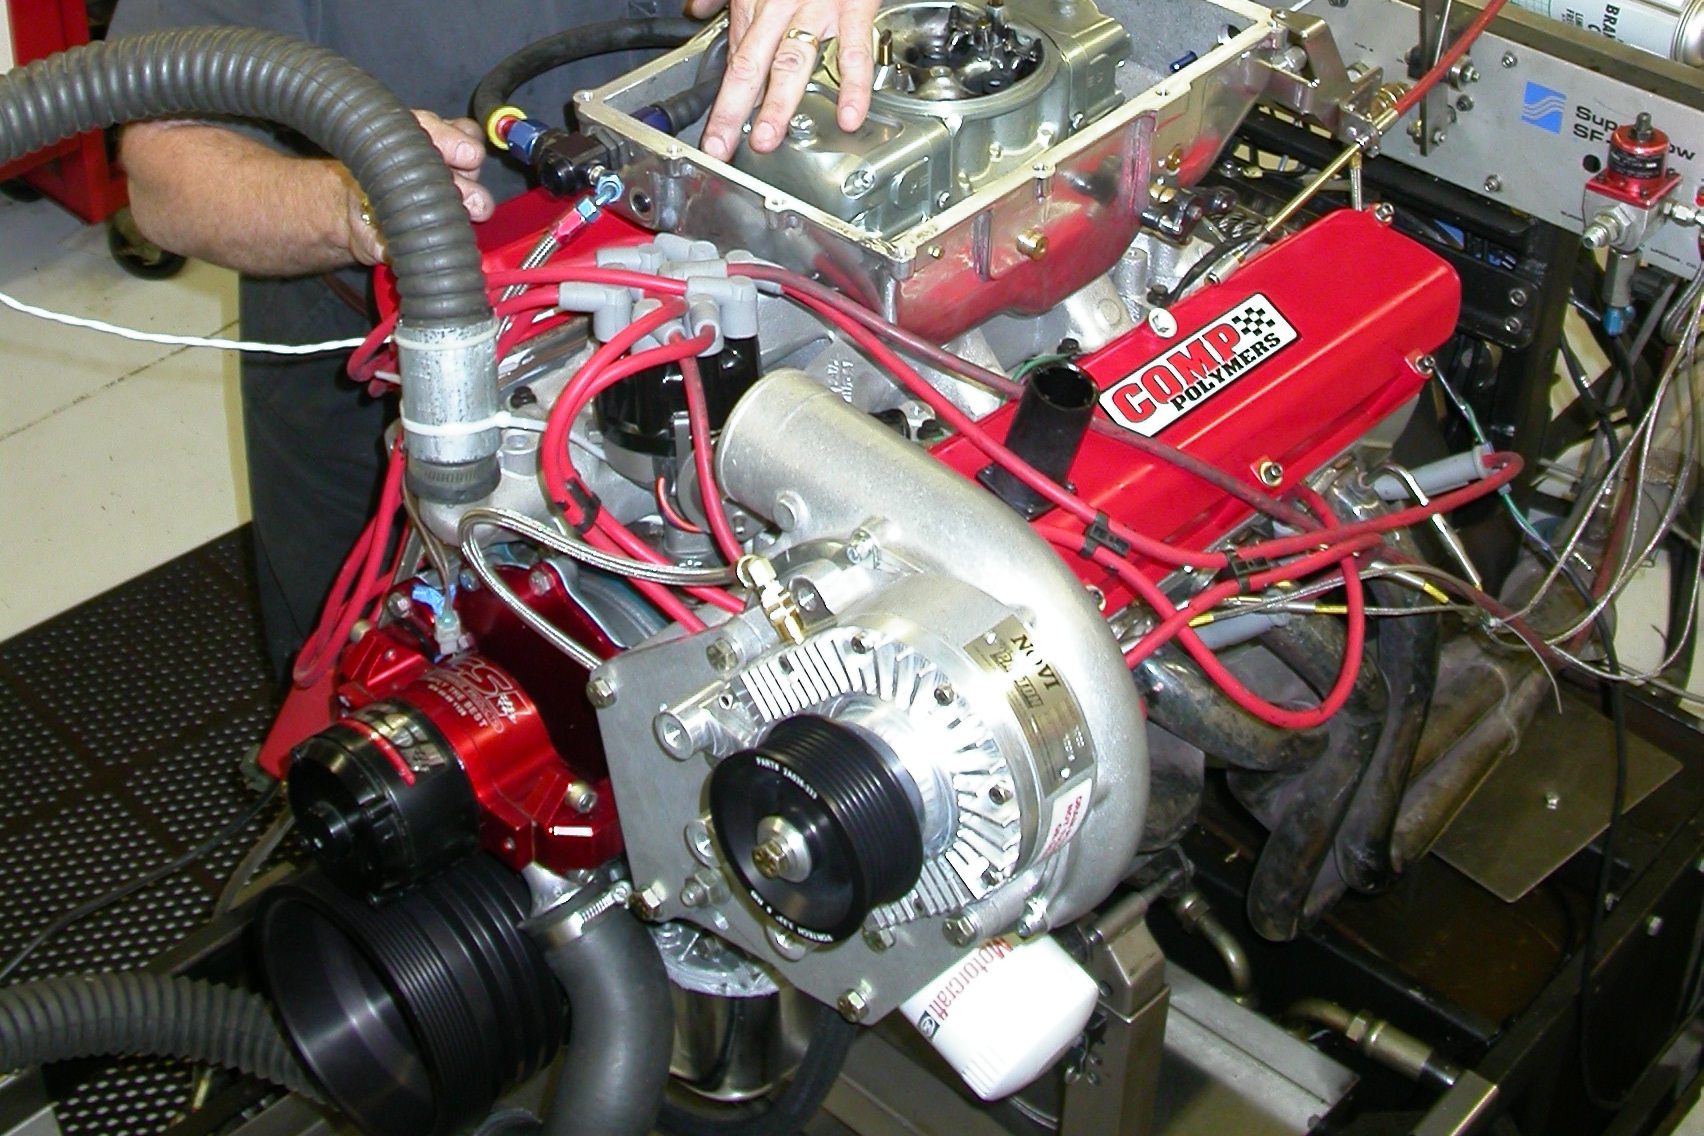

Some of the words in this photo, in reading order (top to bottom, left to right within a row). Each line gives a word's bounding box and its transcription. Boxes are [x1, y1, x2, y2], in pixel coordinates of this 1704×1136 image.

[1111, 323, 1241, 423] COMP
[1169, 332, 1281, 412] POLYMERS
[464, 700, 489, 728] BEST
[929, 936, 1014, 1021] Motorcraft
